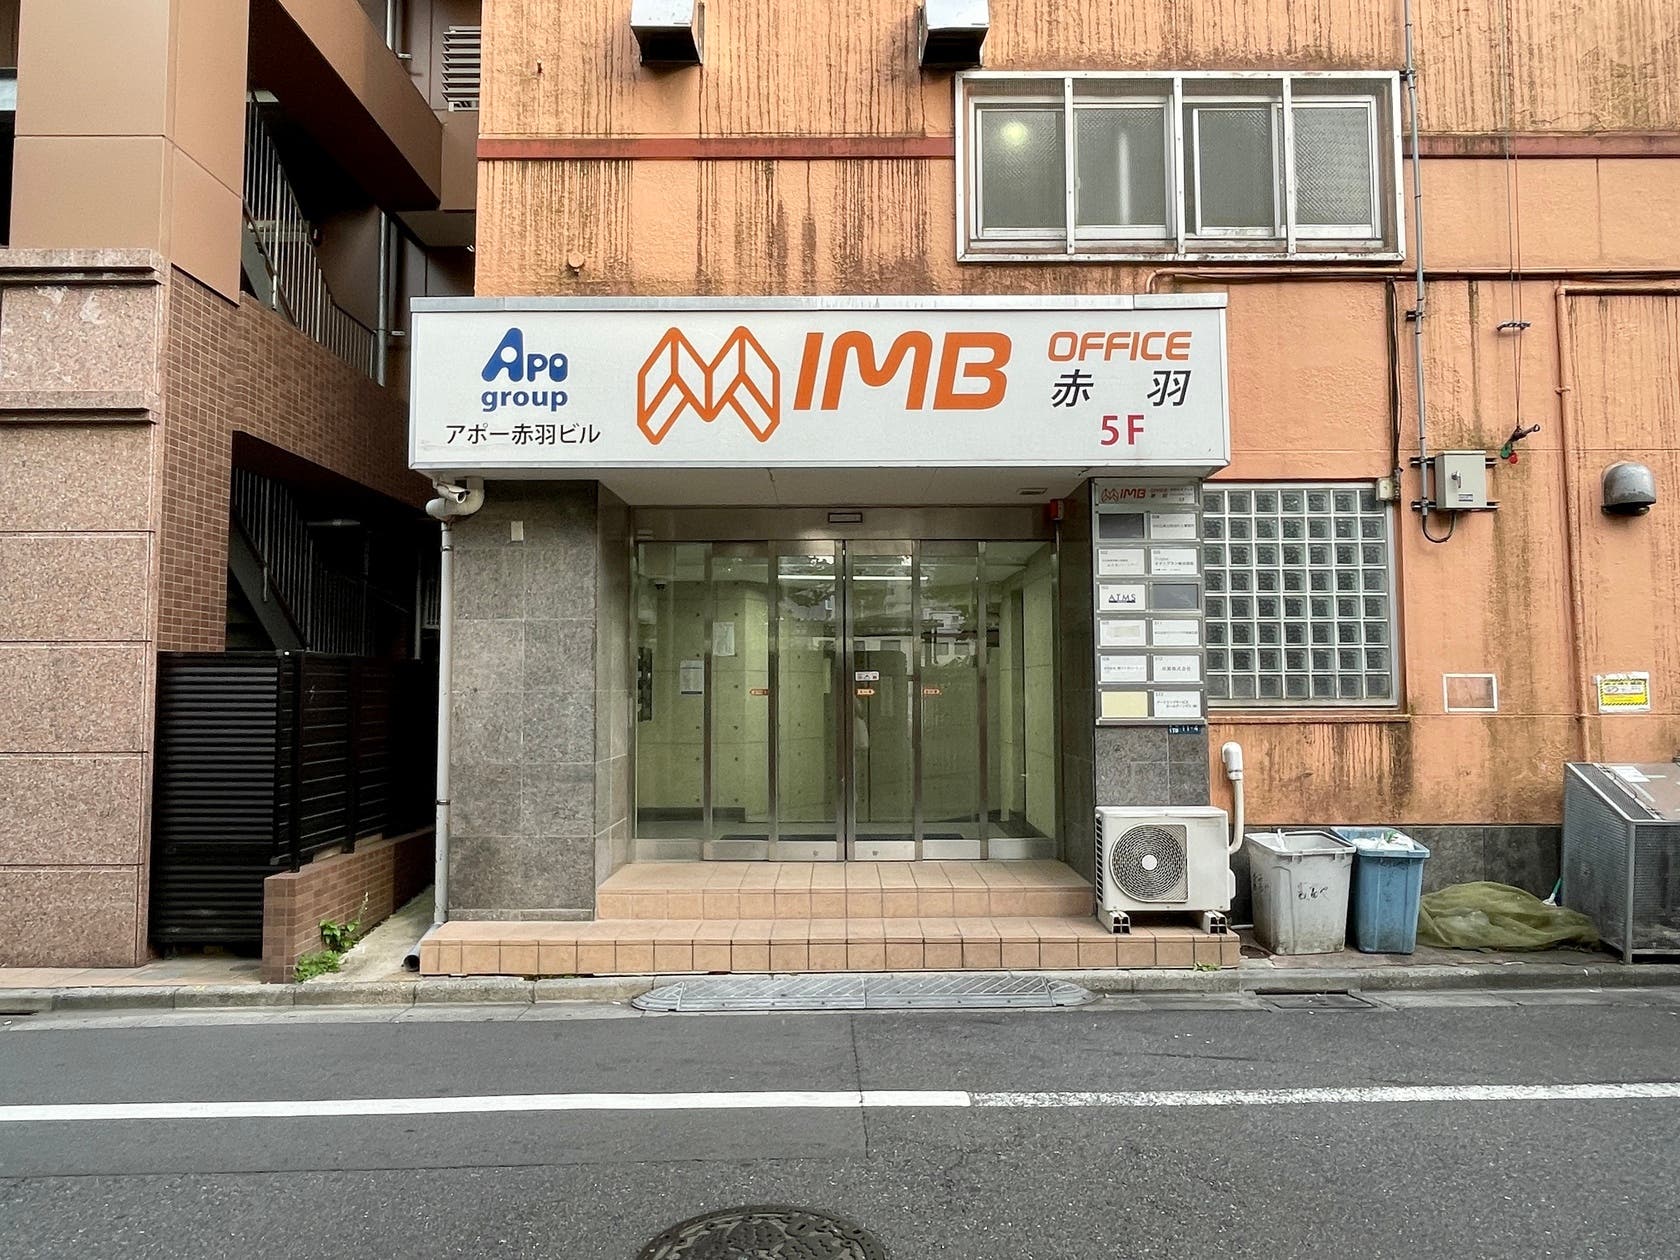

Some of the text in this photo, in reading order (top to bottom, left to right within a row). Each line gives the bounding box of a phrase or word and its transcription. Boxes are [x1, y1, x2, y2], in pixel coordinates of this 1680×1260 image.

[1047, 331, 1193, 362] OFFICE
[793, 330, 1012, 411] IMB
[481, 390, 568, 413] group
[446, 423, 601, 446] アポー赤羽ビル
[1100, 414, 1145, 446] 5F
[1120, 488, 1147, 499] IMB
